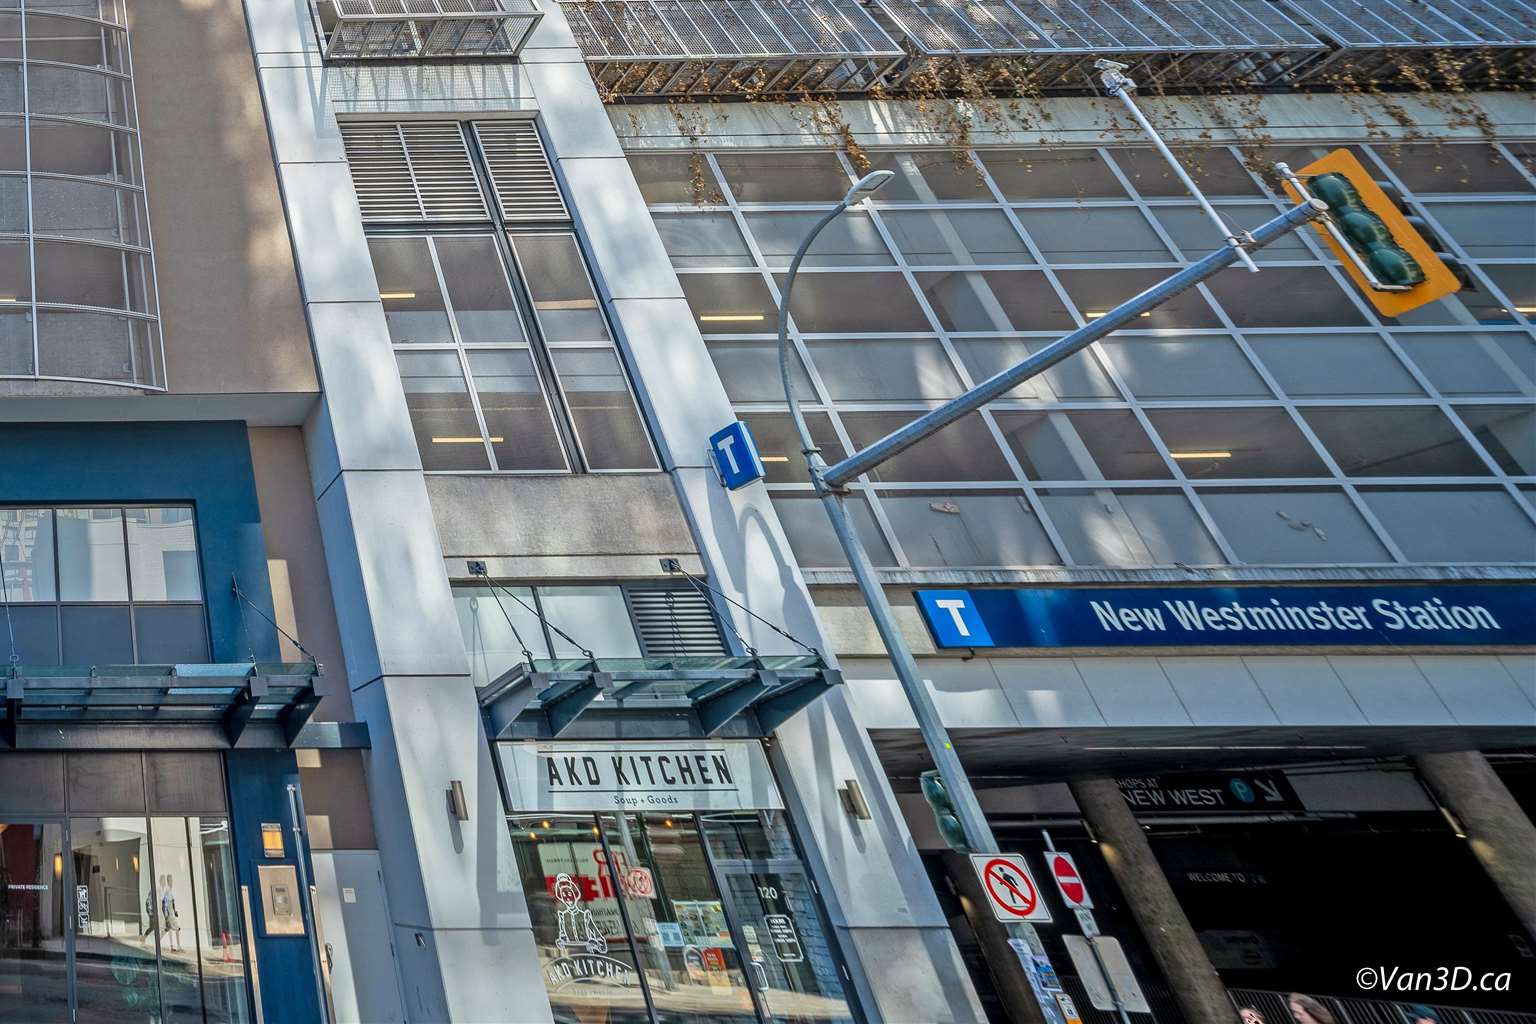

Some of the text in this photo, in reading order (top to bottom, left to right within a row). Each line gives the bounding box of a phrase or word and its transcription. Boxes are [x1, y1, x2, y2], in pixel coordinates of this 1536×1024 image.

[935, 597, 1502, 637] T New Westminster Station
[546, 754, 734, 786] AKD KITCHEN
[1117, 778, 1160, 789] HOPS AT
[614, 795, 638, 806] Soup
[647, 794, 678, 805] Goods
[1167, 789, 1226, 806] WEST
[1186, 872, 1232, 883] WELCOME
[757, 886, 778, 900] 120
[573, 959, 632, 986] KITCHEN
